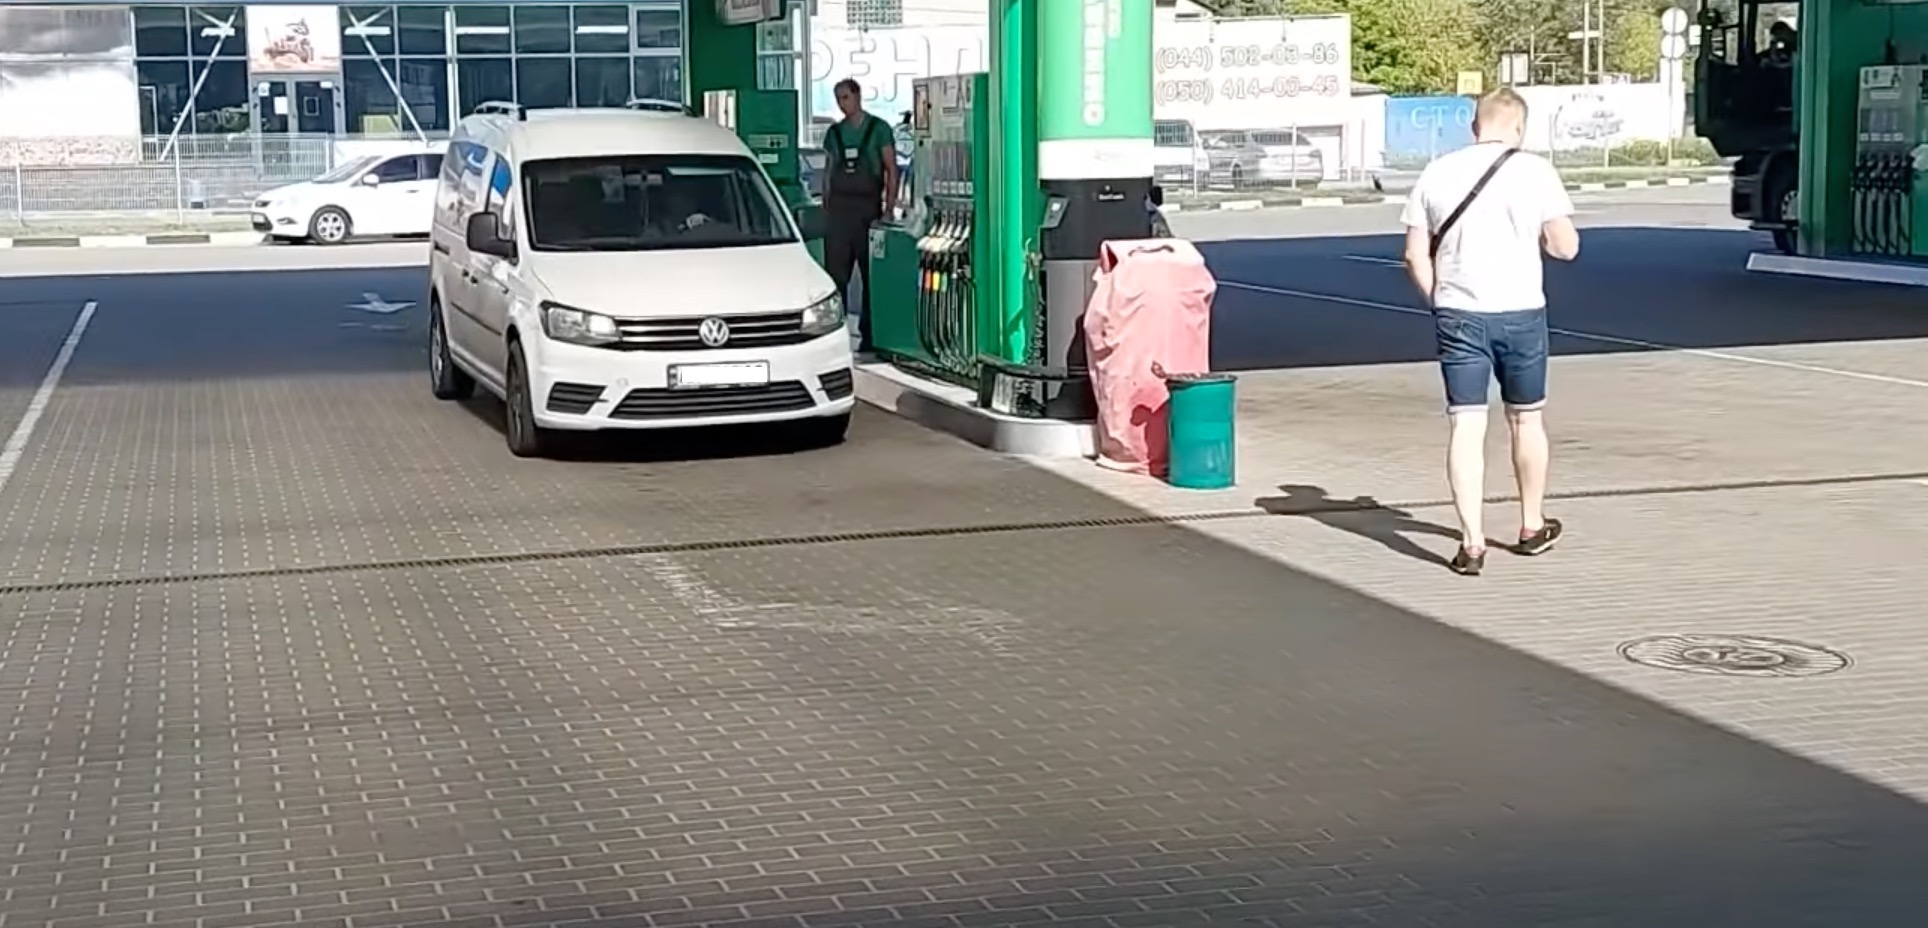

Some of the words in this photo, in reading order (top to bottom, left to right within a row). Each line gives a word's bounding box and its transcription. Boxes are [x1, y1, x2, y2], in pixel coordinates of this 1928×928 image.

[1156, 46, 1213, 73] (044)
[1155, 78, 1214, 106] (050)
[1220, 74, 1340, 99] 414-00-45
